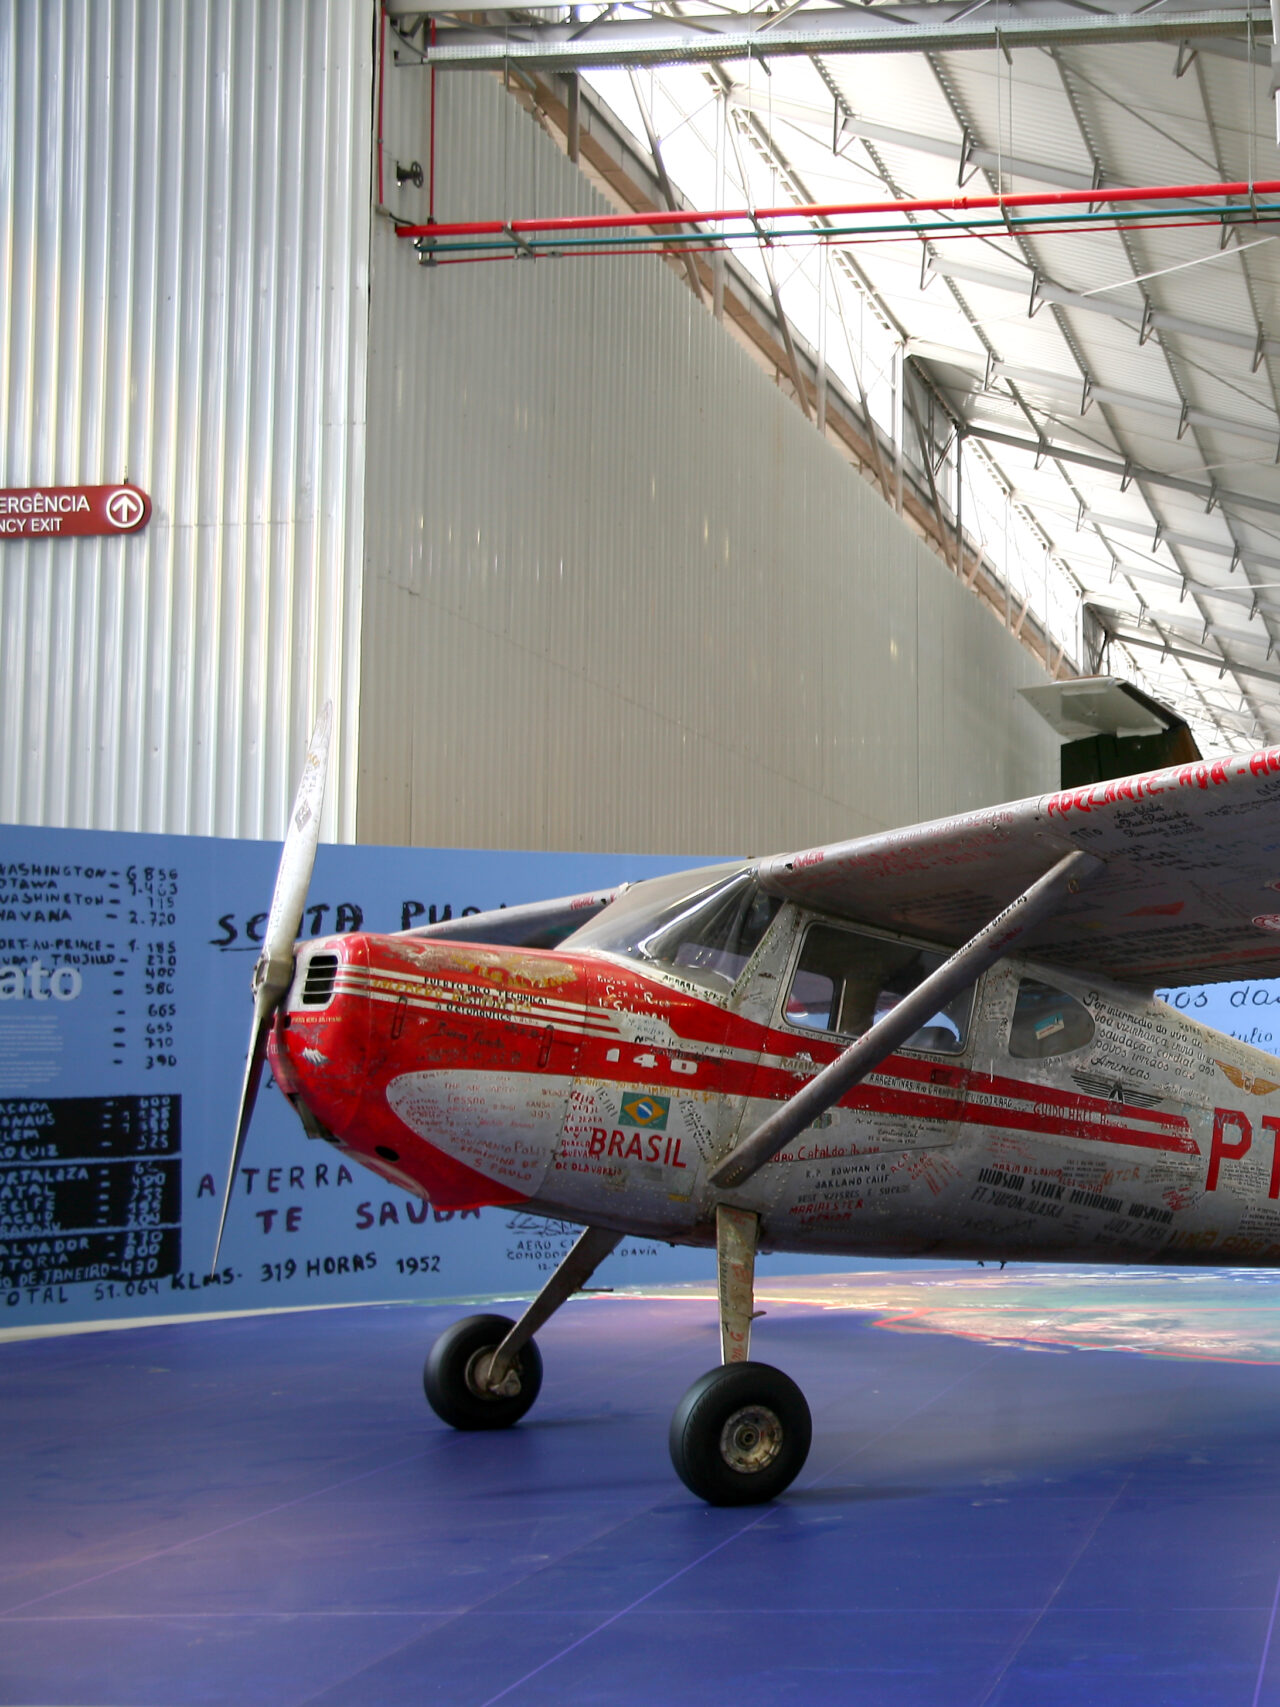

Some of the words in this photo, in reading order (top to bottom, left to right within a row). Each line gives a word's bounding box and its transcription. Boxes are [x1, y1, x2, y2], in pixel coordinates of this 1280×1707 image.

[32, 518, 62, 531] EXIT
[1084, 992, 1107, 1012] Por
[1095, 1013, 1113, 1027] boa
[589, 1128, 687, 1168] BRASIL
[198, 1170, 215, 1197] A
[242, 1164, 353, 1191] TERRA
[257, 1208, 303, 1233] TE
[262, 1263, 296, 1280] 319
[307, 1253, 378, 1276] HORAS
[397, 1256, 441, 1274] 1952
